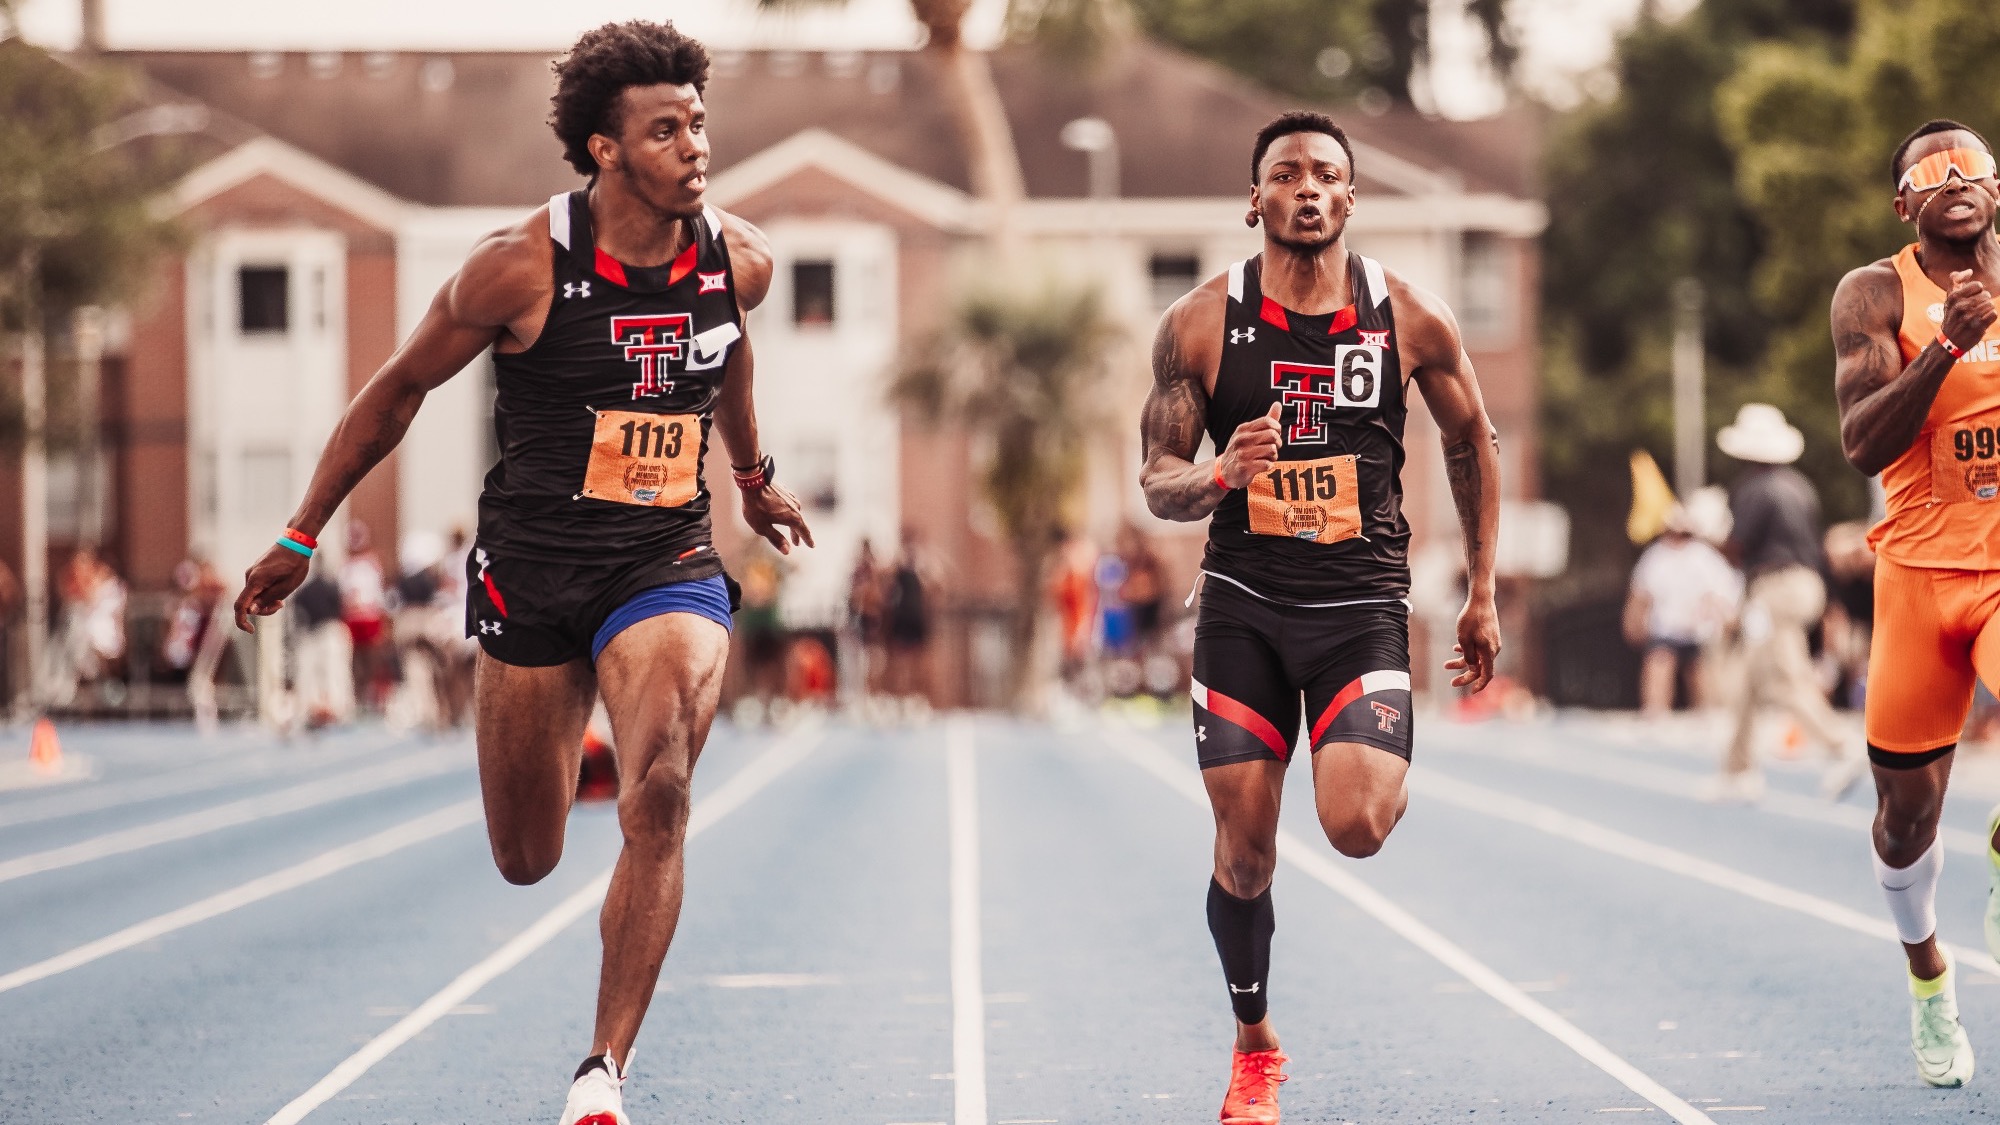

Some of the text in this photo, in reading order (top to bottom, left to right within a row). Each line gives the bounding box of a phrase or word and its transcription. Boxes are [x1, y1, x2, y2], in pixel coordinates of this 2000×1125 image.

[1341, 349, 1375, 402] 6
[619, 420, 684, 459] 1113
[1954, 426, 2000, 462] 99
[1267, 465, 1337, 501] 1115
